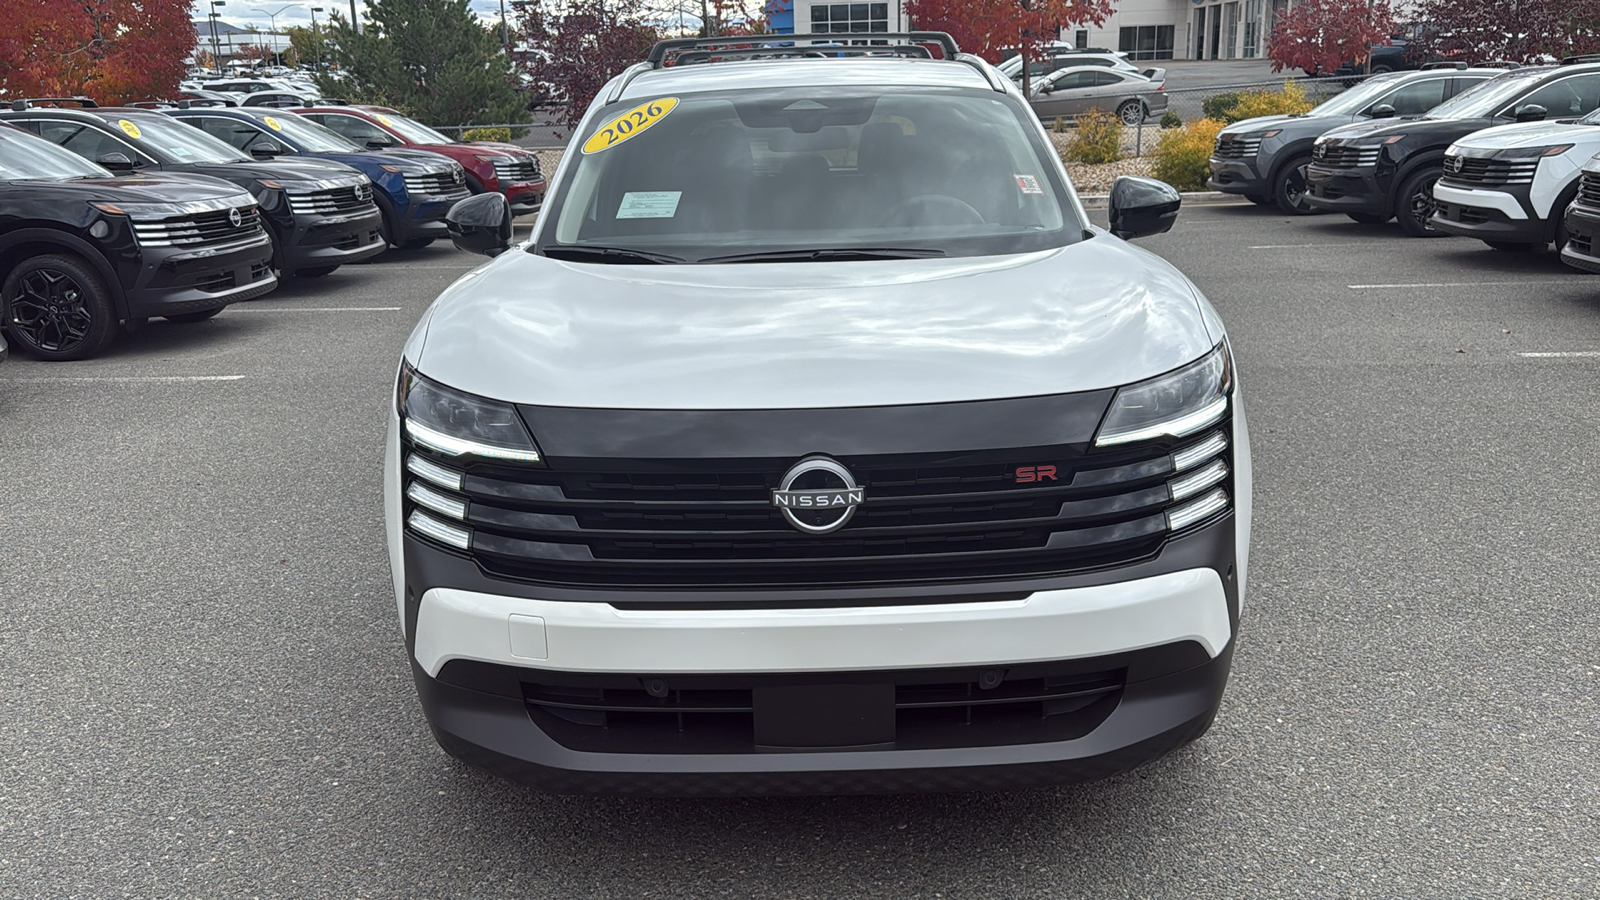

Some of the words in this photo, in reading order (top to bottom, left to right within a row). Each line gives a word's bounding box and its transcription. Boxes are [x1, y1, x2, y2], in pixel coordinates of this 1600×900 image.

[601, 102, 662, 145] 2026
[1016, 465, 1057, 483] SR
[775, 491, 862, 506] NISSAN
